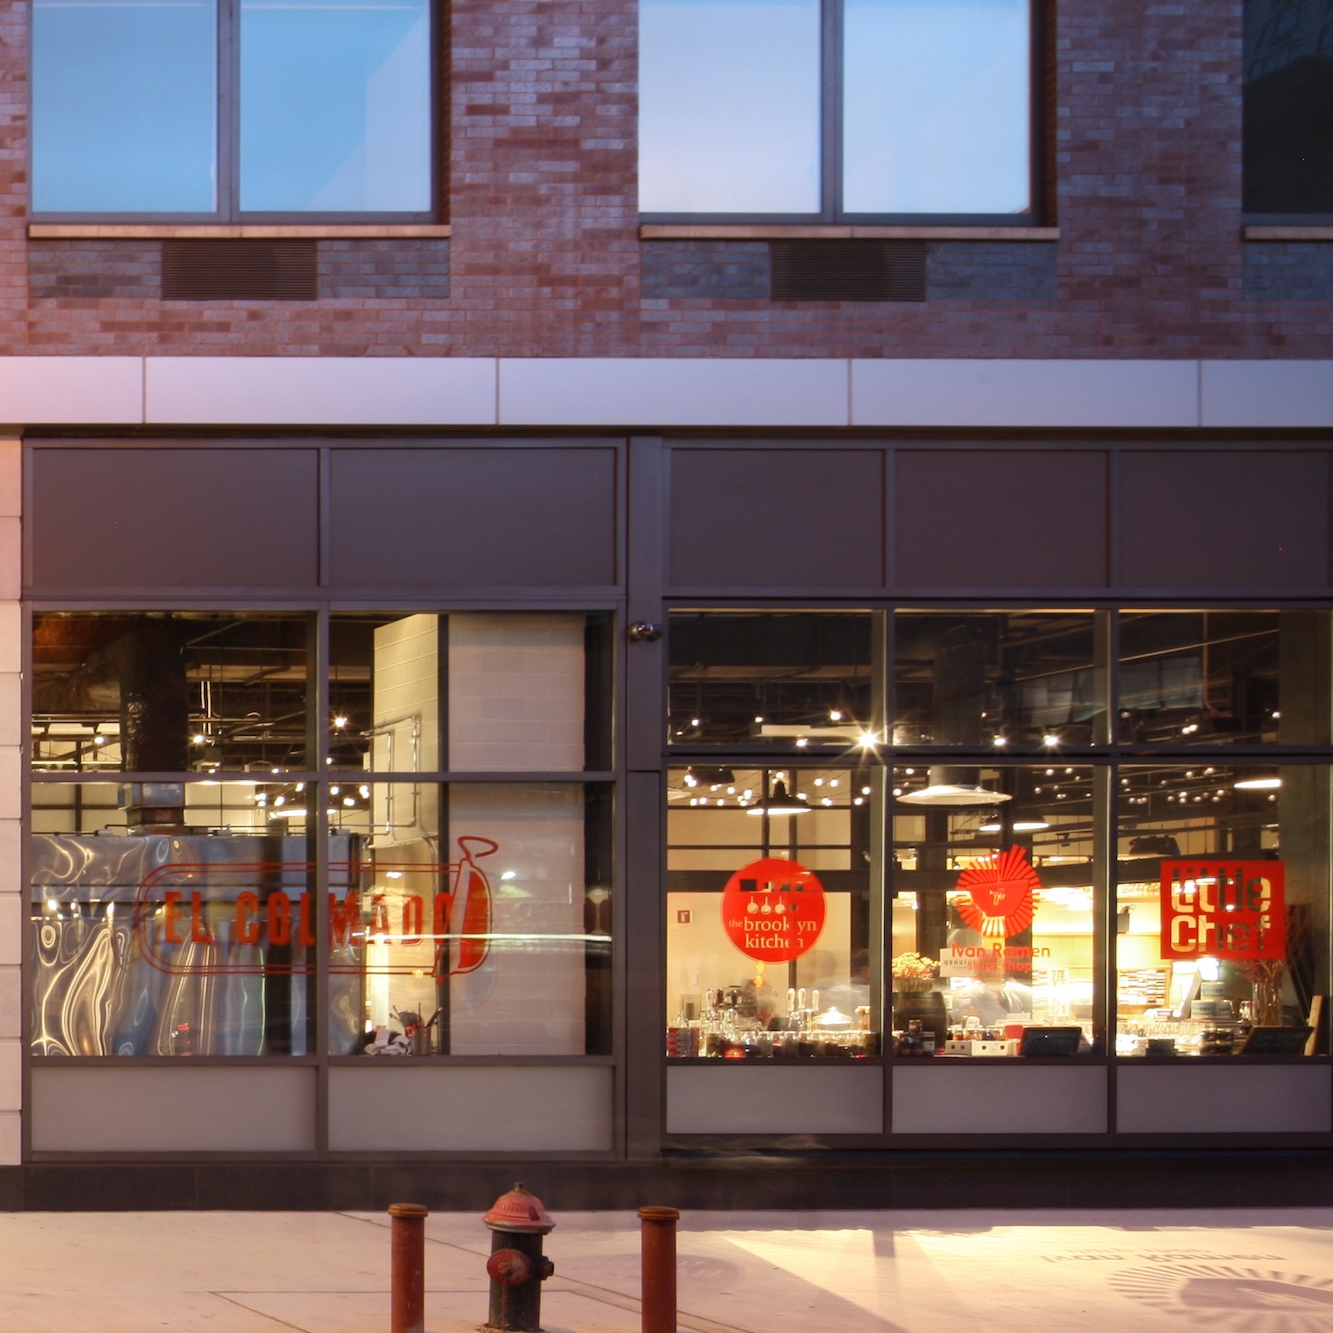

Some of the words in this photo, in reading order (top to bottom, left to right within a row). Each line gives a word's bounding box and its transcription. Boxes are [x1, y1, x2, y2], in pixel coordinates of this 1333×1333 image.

[164, 891, 217, 945] EL
[744, 916, 817, 935] brookyn
[951, 941, 987, 958] Ivan
[992, 942, 1051, 958] Ramen
